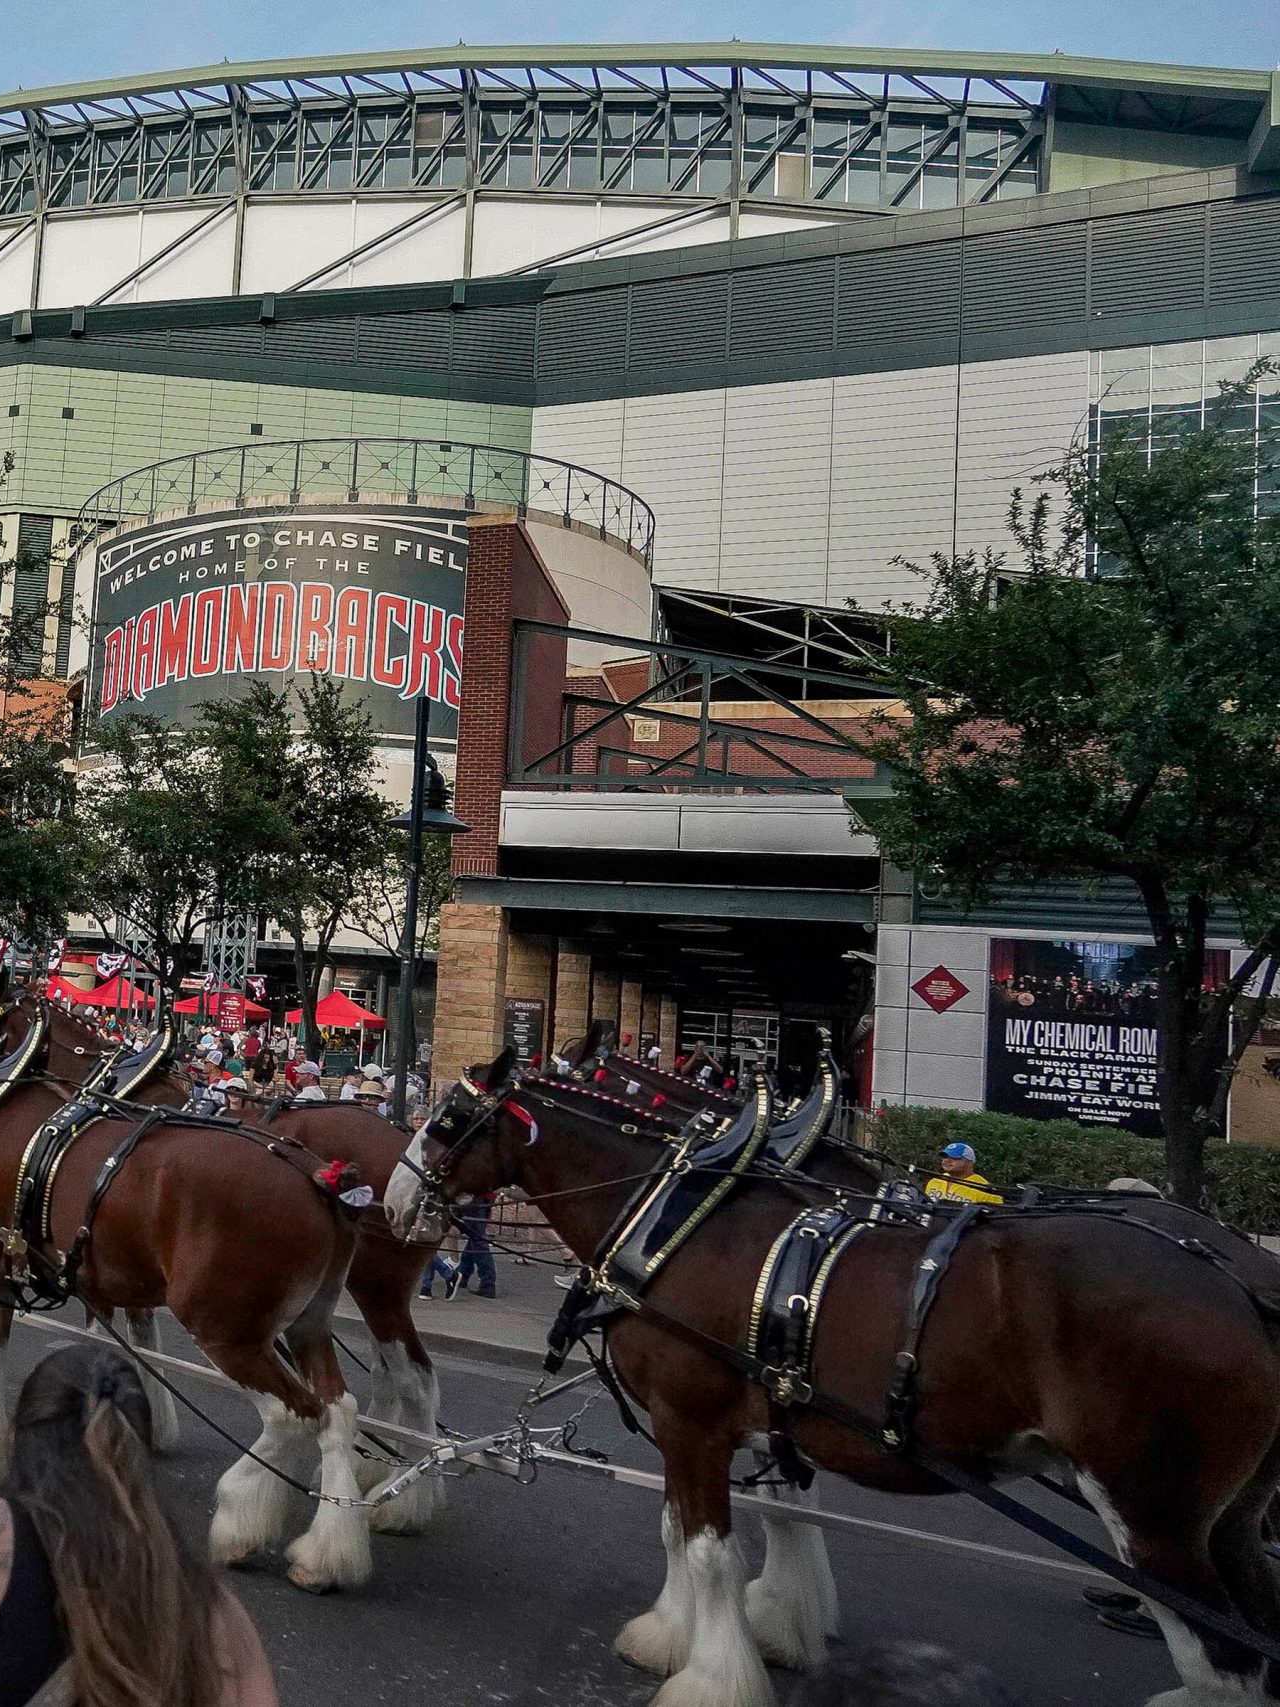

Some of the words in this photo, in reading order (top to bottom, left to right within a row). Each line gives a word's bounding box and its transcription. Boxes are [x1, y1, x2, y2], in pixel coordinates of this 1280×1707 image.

[109, 538, 215, 595] WELCOME
[225, 531, 260, 550] TO
[274, 530, 380, 552] CHASE
[394, 539, 464, 573] FIEL
[178, 559, 247, 584] HOME
[264, 557, 298, 571] OF
[316, 558, 371, 575] THE
[99, 581, 464, 719] DIAMONDBACKS
[1005, 1018, 1032, 1046] MY
[1033, 1020, 1116, 1053] CHEMICAL
[1118, 1026, 1158, 1057] ROM
[1005, 1045, 1036, 1055] THE
[1040, 1048, 1091, 1060] BLACK
[1095, 1052, 1157, 1064] PARADE
[1027, 1058, 1077, 1069] SUNDAY
[1079, 1062, 1157, 1075] SEPTEMBER
[1012, 1073, 1101, 1092] CHASE
[1110, 1082, 1160, 1097] FIE
[1135, 1074, 1158, 1084] AZ
[1024, 1090, 1079, 1103] JIMMY
[1080, 1096, 1113, 1106] EAT
[1116, 1099, 1161, 1111] WOR
[1081, 1107, 1107, 1116] SALE
[1107, 1110, 1132, 1118] NOW
